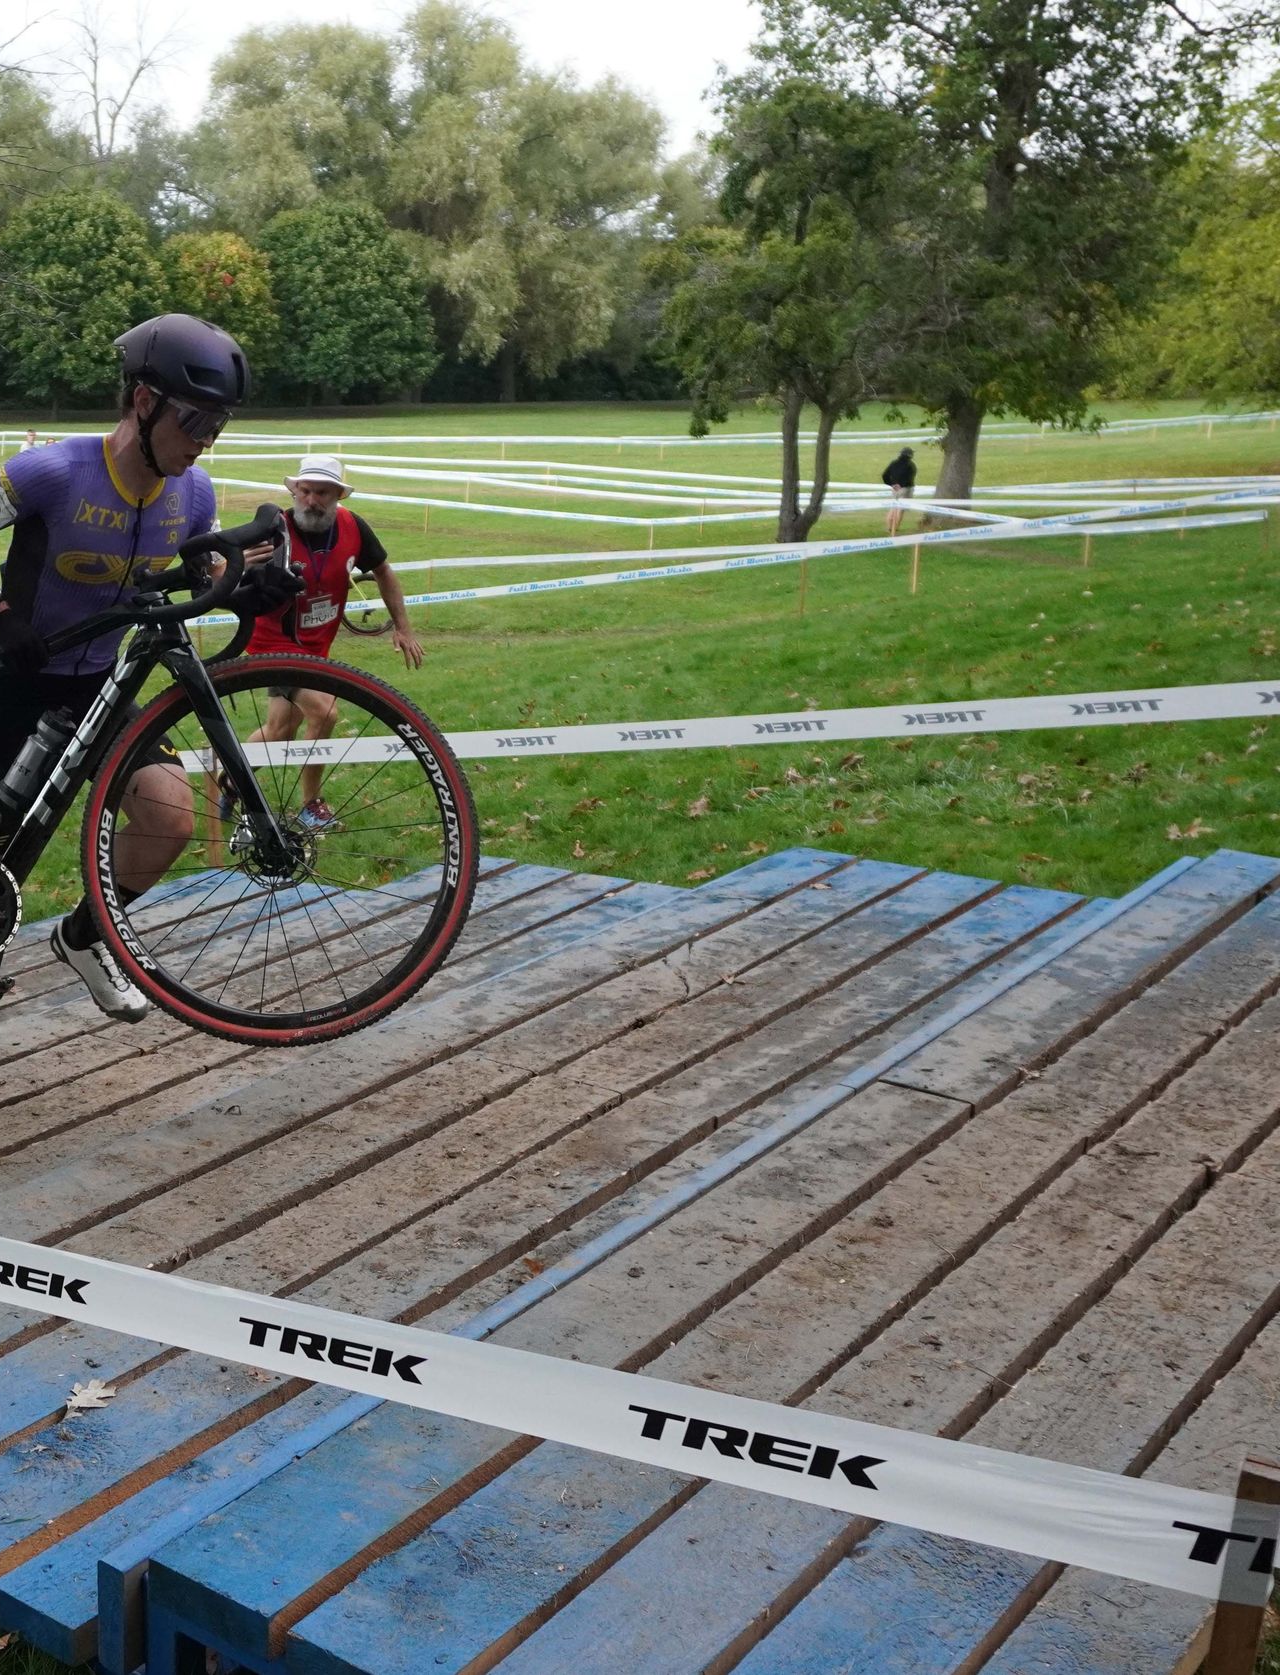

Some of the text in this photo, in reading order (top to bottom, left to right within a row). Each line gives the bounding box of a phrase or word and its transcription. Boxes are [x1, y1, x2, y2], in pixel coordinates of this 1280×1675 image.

[421, 595, 449, 603] Moon
[449, 591, 477, 600] Vista
[665, 567, 693, 575] Vista
[21, 649, 139, 827] TREK
[397, 723, 460, 887] BONTRAGER
[97, 808, 157, 970] BONTRAGER
[239, 1316, 428, 1386] TREK
[629, 1404, 888, 1491] TREK
